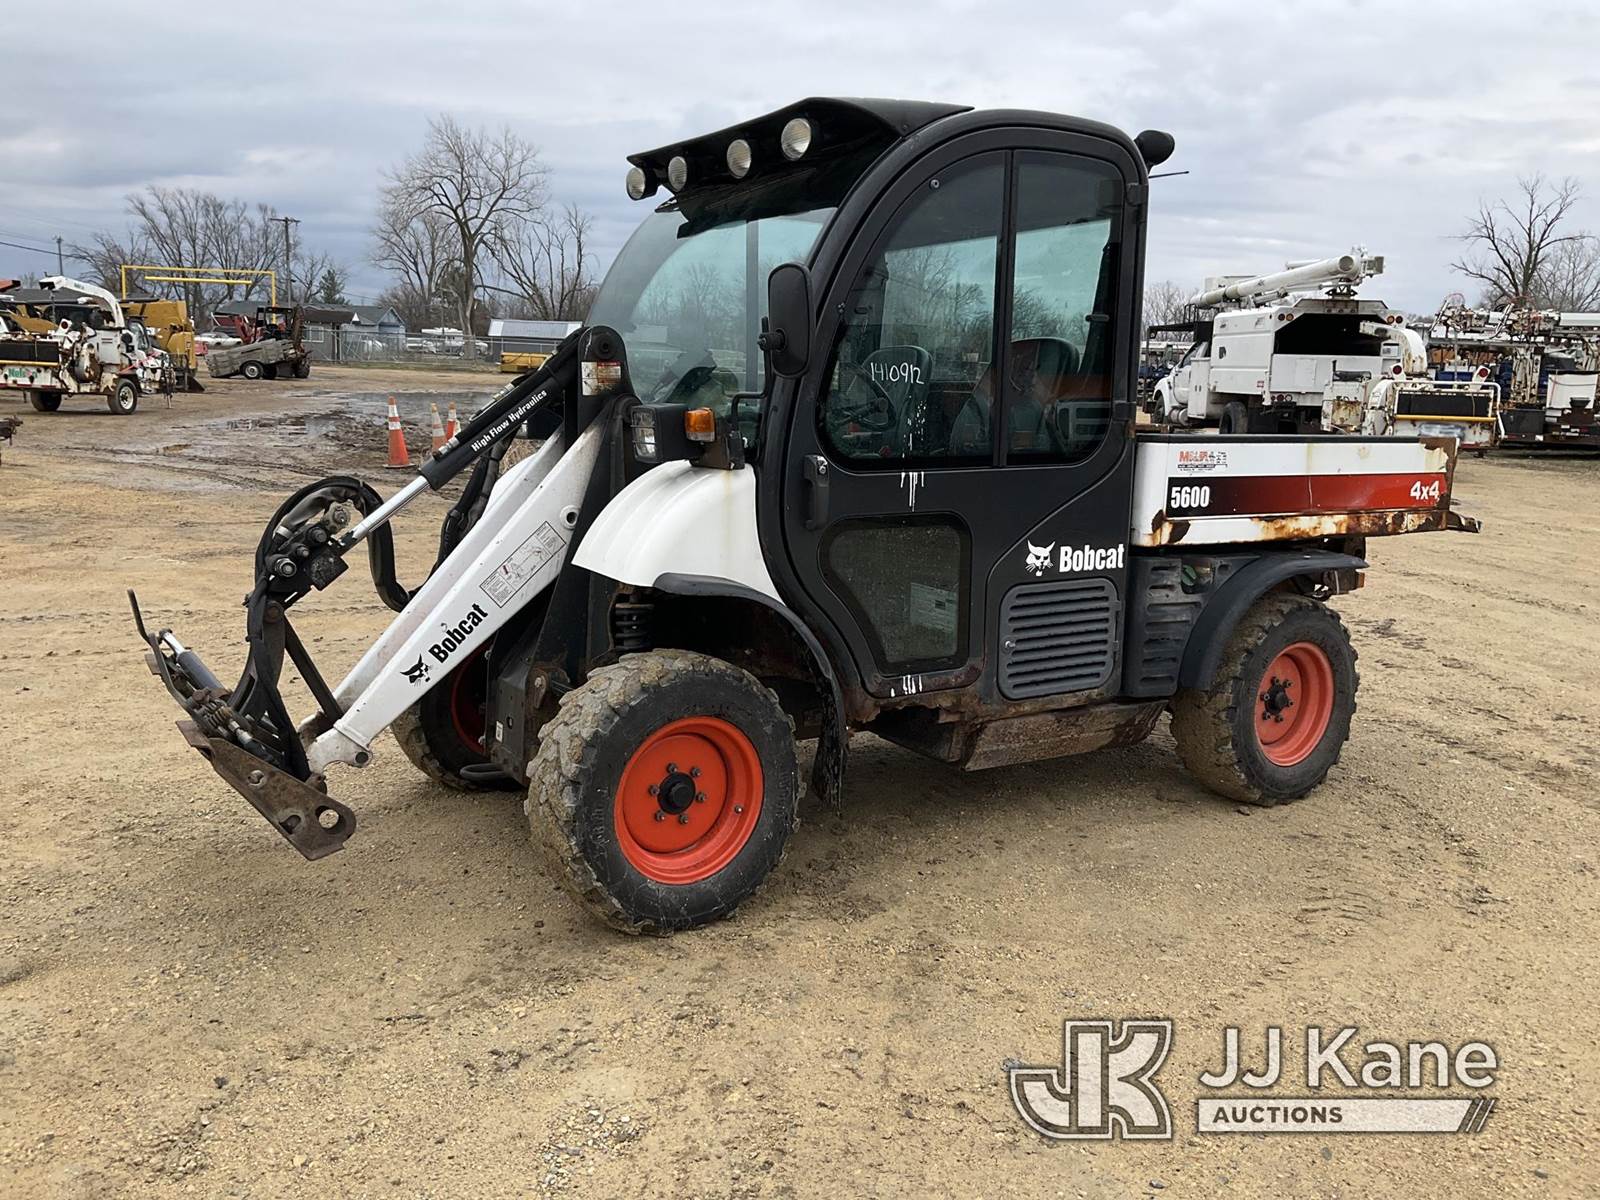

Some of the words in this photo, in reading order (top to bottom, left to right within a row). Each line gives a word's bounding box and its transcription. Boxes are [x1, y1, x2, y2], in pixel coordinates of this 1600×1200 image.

[870, 361, 925, 385] 1410912
[471, 433, 492, 452] High
[488, 419, 510, 438] Flow
[508, 390, 547, 422] Hydraulics
[1170, 485, 1210, 509] 5600
[1409, 480, 1440, 501] 4x4
[1059, 543, 1125, 573] Bobcat
[428, 603, 489, 664] Bobcat
